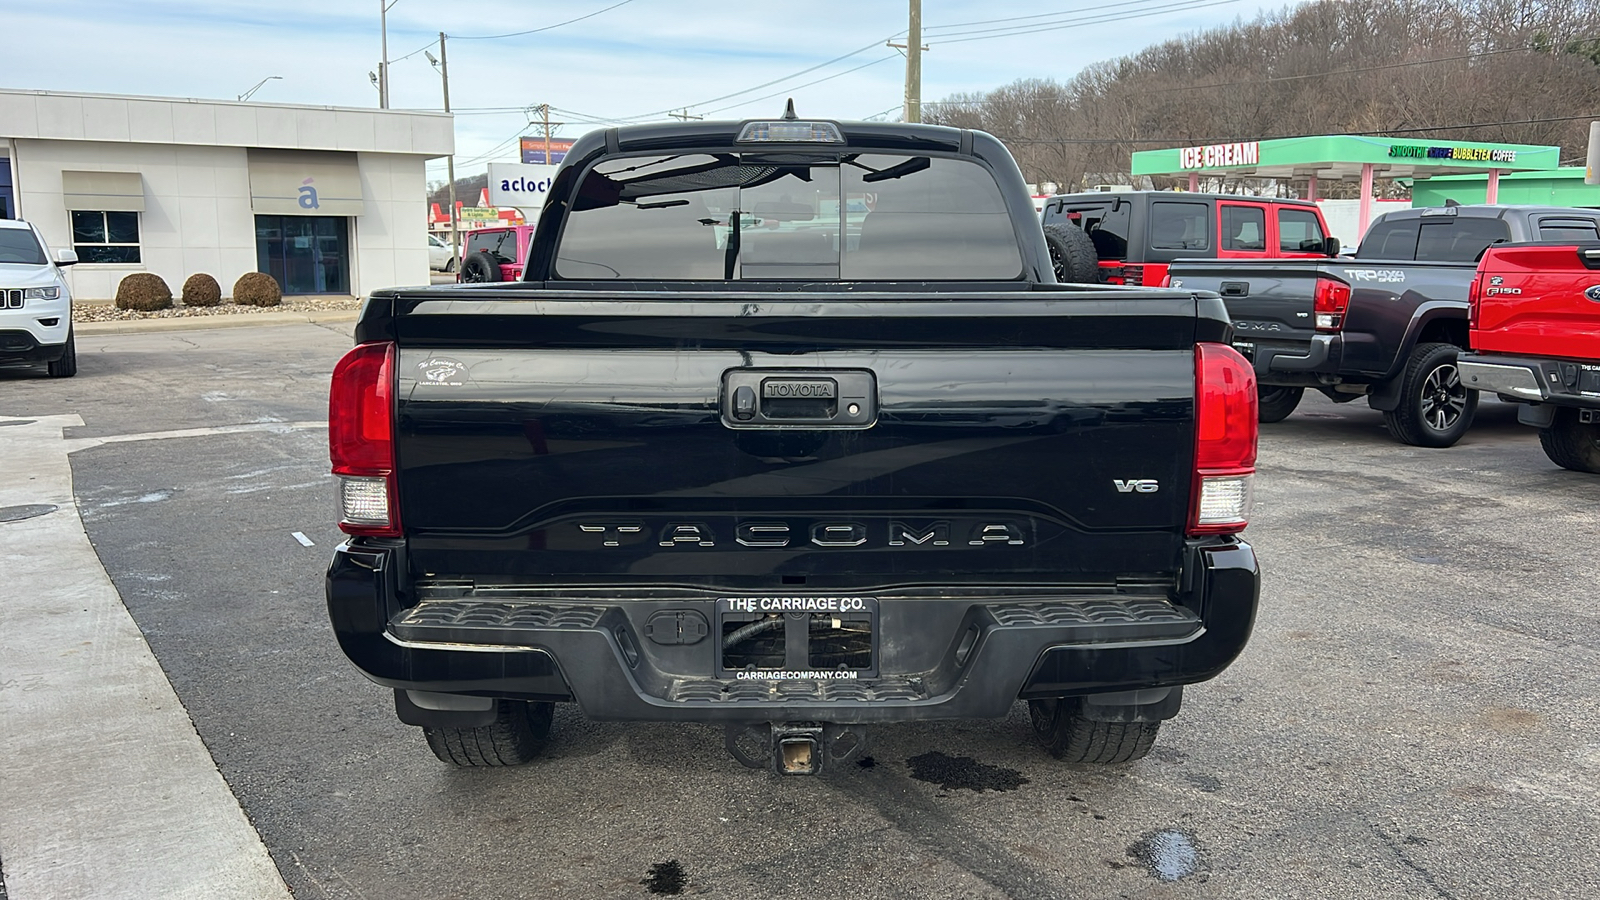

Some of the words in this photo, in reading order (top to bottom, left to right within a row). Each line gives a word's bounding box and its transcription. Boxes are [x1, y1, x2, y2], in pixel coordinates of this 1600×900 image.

[1180, 146, 1204, 169] ICE
[1205, 141, 1260, 167] CREAM
[1492, 150, 1516, 162] COFFEE
[1344, 269, 1377, 281] TRD
[1231, 320, 1281, 331] OMA
[429, 359, 455, 368] Carriage
[767, 384, 832, 397] TOYOTA
[1113, 479, 1159, 493] V6
[579, 519, 1026, 547] TACOMA
[727, 598, 757, 610] THE
[760, 597, 837, 610] CARRIAGE
[840, 597, 866, 610] CO.
[736, 671, 858, 680] CARRIAGECOMPANY.COM
